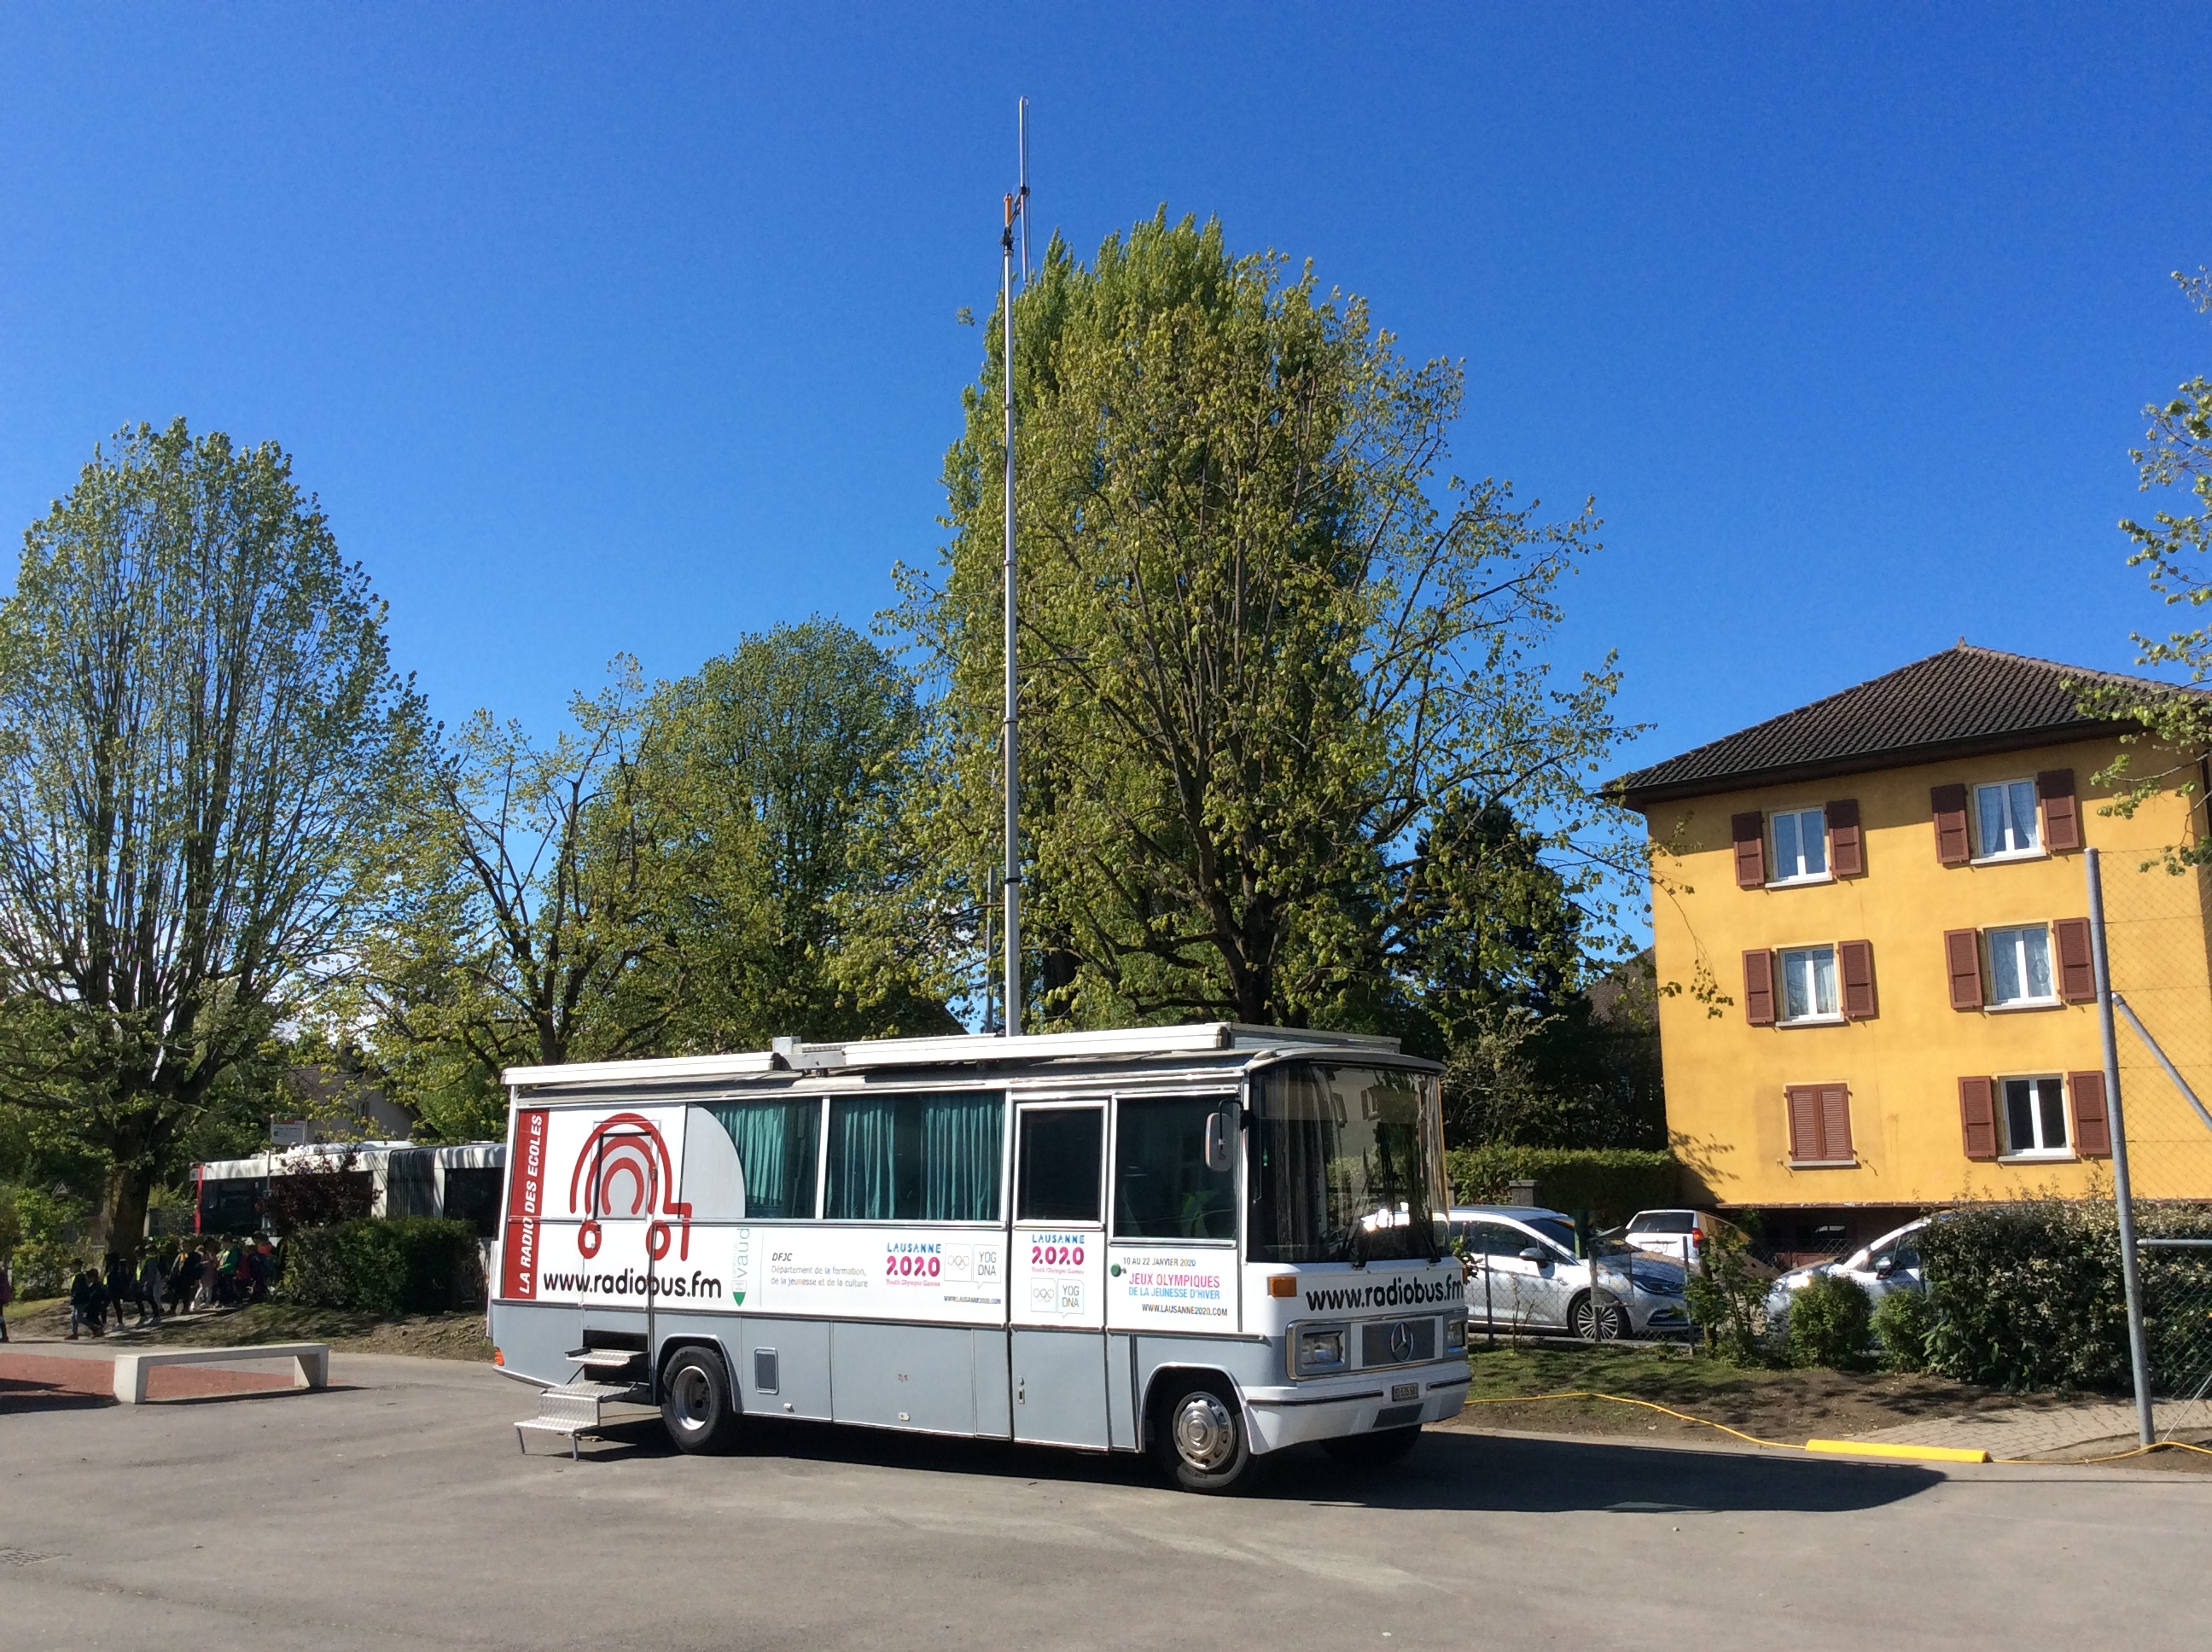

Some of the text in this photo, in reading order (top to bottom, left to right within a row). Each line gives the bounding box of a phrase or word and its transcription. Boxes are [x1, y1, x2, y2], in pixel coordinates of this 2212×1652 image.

[519, 1114, 543, 1294] LA RADIO DES ECOLES
[1032, 1234, 1085, 1244] LAUSANNE
[736, 1228, 750, 1278] vaud
[887, 1242, 941, 1254] LAUSANNE
[771, 1252, 793, 1262] DFJC
[978, 1251, 997, 1263] YOG
[1032, 1246, 1085, 1265] 2020
[886, 1255, 940, 1277] 2020
[1152, 1258, 1179, 1266] JANVIER
[1180, 1259, 1196, 1267] 2020
[771, 1265, 813, 1275] Département
[832, 1266, 867, 1277] formation,
[977, 1264, 997, 1277] DNA
[543, 1267, 722, 1299] www.radiobus.fm
[771, 1277, 869, 1288] de la jeunesse et de la culture
[1129, 1272, 1220, 1288] JEUX OLYMPIQUES
[1062, 1284, 1080, 1296] YOG
[1128, 1286, 1220, 1300] DE LA JEUNESSE D'HIVER
[1306, 1273, 1464, 1312] www.radiobus.fm
[943, 1295, 1002, 1305] WWW.LAUSANNE2020.COM
[1062, 1297, 1080, 1308] DNA
[1141, 1304, 1228, 1316] WWW.LAUSANNE2020.COM
